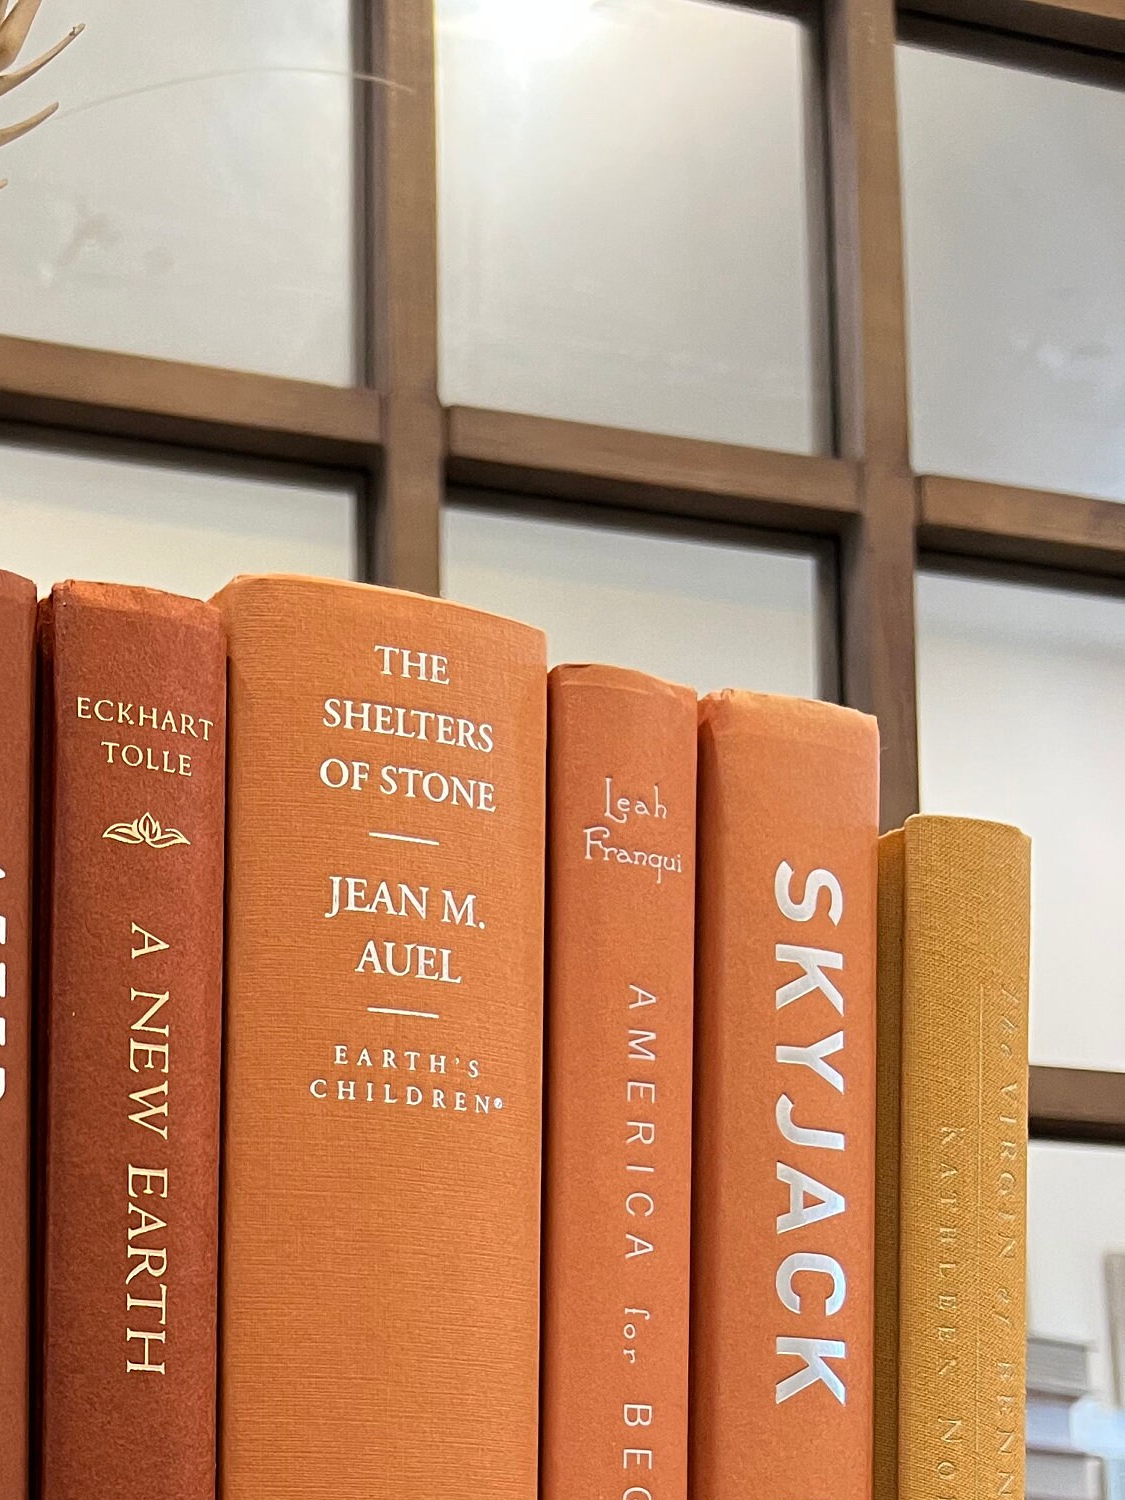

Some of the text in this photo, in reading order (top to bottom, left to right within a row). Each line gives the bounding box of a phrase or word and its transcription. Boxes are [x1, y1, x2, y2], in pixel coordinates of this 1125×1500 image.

[374, 644, 450, 686] THE
[76, 696, 215, 742] ECKHART
[322, 698, 495, 754] SHELTERS
[101, 741, 193, 778] TOLLE
[319, 758, 497, 813] OF STONE
[603, 776, 668, 824] Leah
[583, 826, 683, 884] Franqui
[324, 876, 486, 930] JEAN M.
[355, 940, 462, 984] AUEL
[334, 1044, 480, 1079] EARTH'S
[125, 921, 171, 1376] A NEW EARTH
[624, 983, 657, 1261] AMERICA
[774, 859, 847, 1405] SKYJACK
[998, 1081, 1020, 1259] VIRGIN
[936, 1126, 965, 1375] KATHLEEN
[623, 1306, 650, 1365] for
